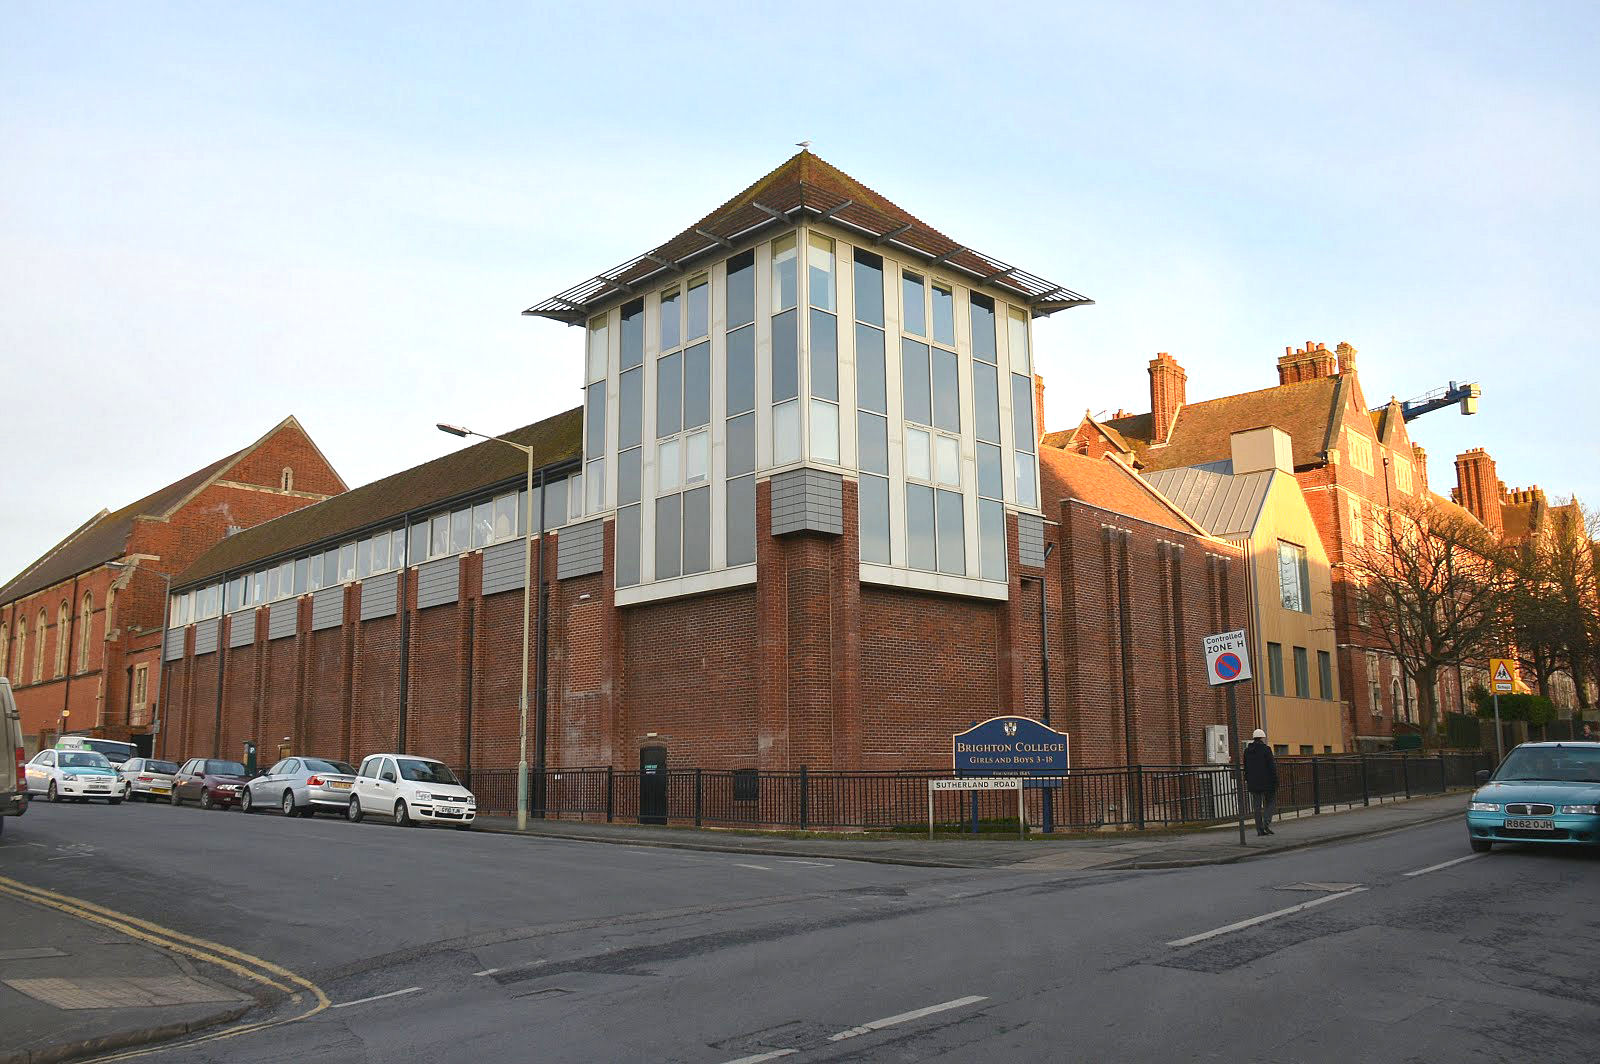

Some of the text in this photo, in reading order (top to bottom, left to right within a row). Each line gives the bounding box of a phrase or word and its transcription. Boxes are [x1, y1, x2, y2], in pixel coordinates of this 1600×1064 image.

[1206, 632, 1242, 644] Controlled
[1208, 640, 1244, 653] ZONE H
[957, 741, 1065, 752] BRIGHTON COLLEGE
[969, 756, 993, 764] GIRLS
[1013, 756, 1034, 764] BOYS
[936, 781, 989, 789] SUTHERLAND
[1506, 820, 1552, 829] R862 OJH
